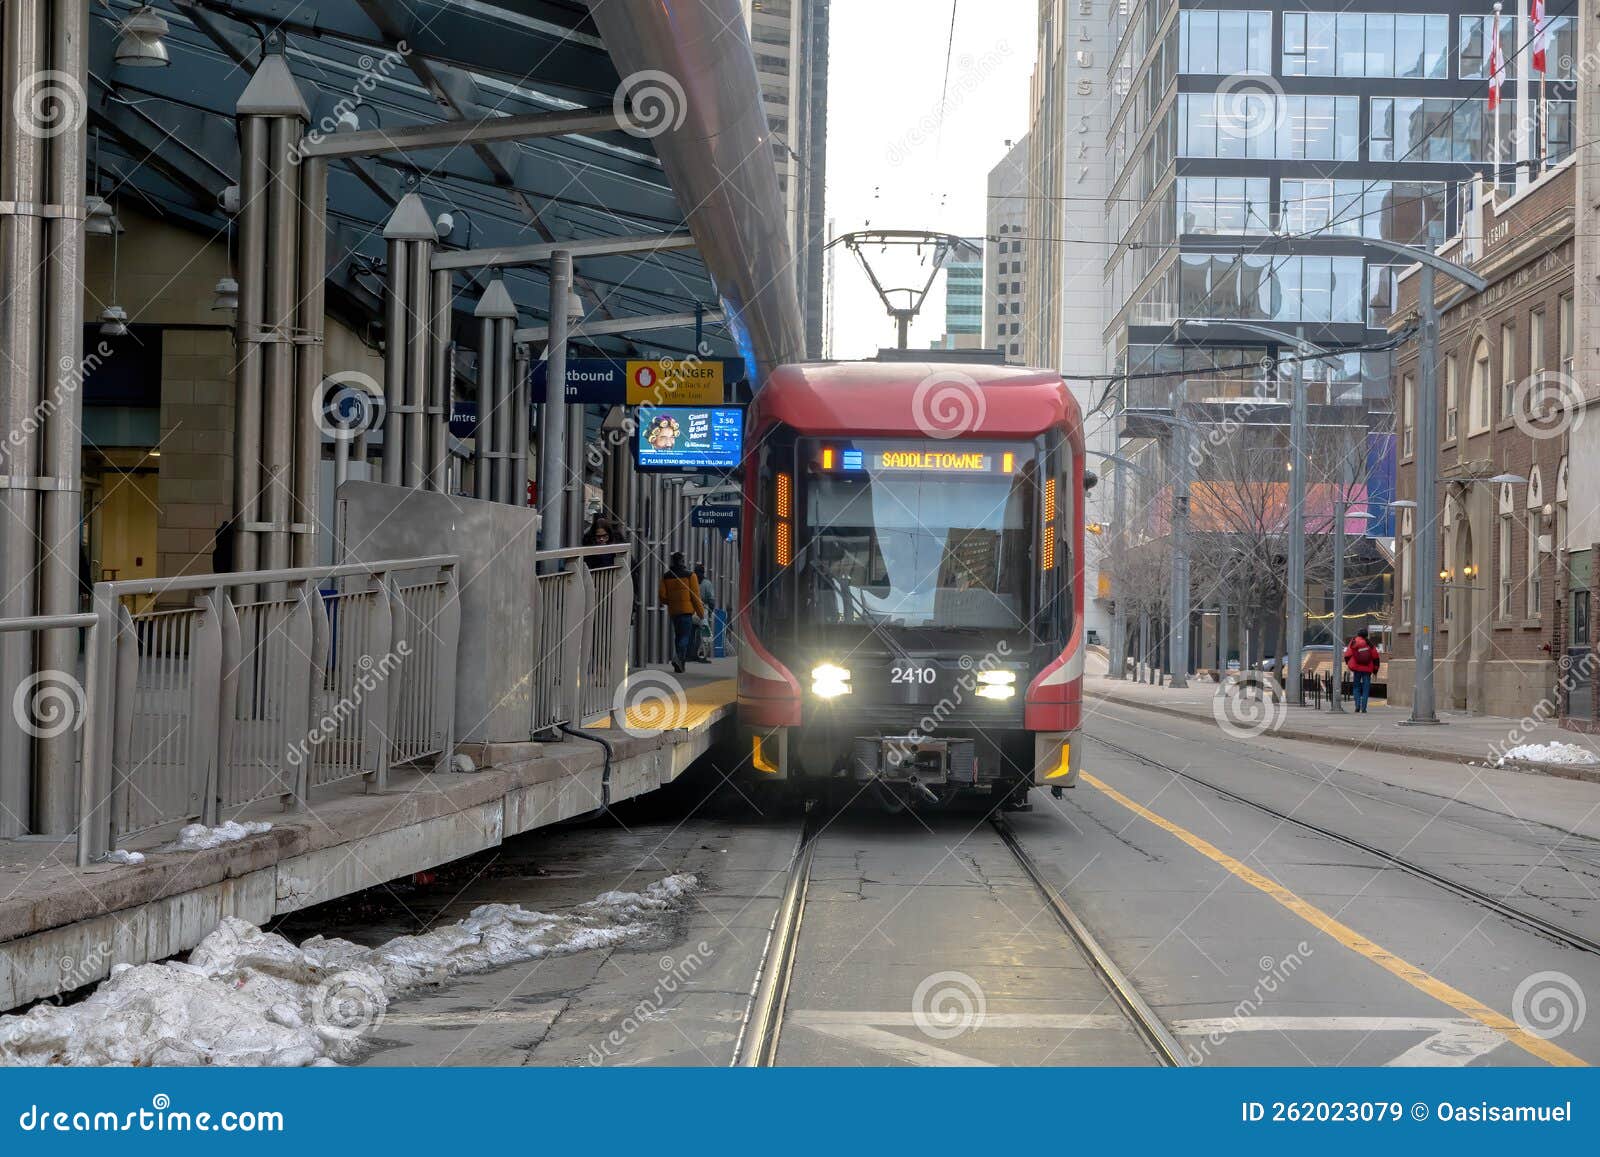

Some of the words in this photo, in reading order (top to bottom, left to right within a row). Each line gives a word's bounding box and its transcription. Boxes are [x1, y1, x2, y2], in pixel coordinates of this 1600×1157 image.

[664, 368, 714, 378] DANGER
[882, 453, 983, 469] SADDLETOWNE
[891, 667, 936, 684] 2410
